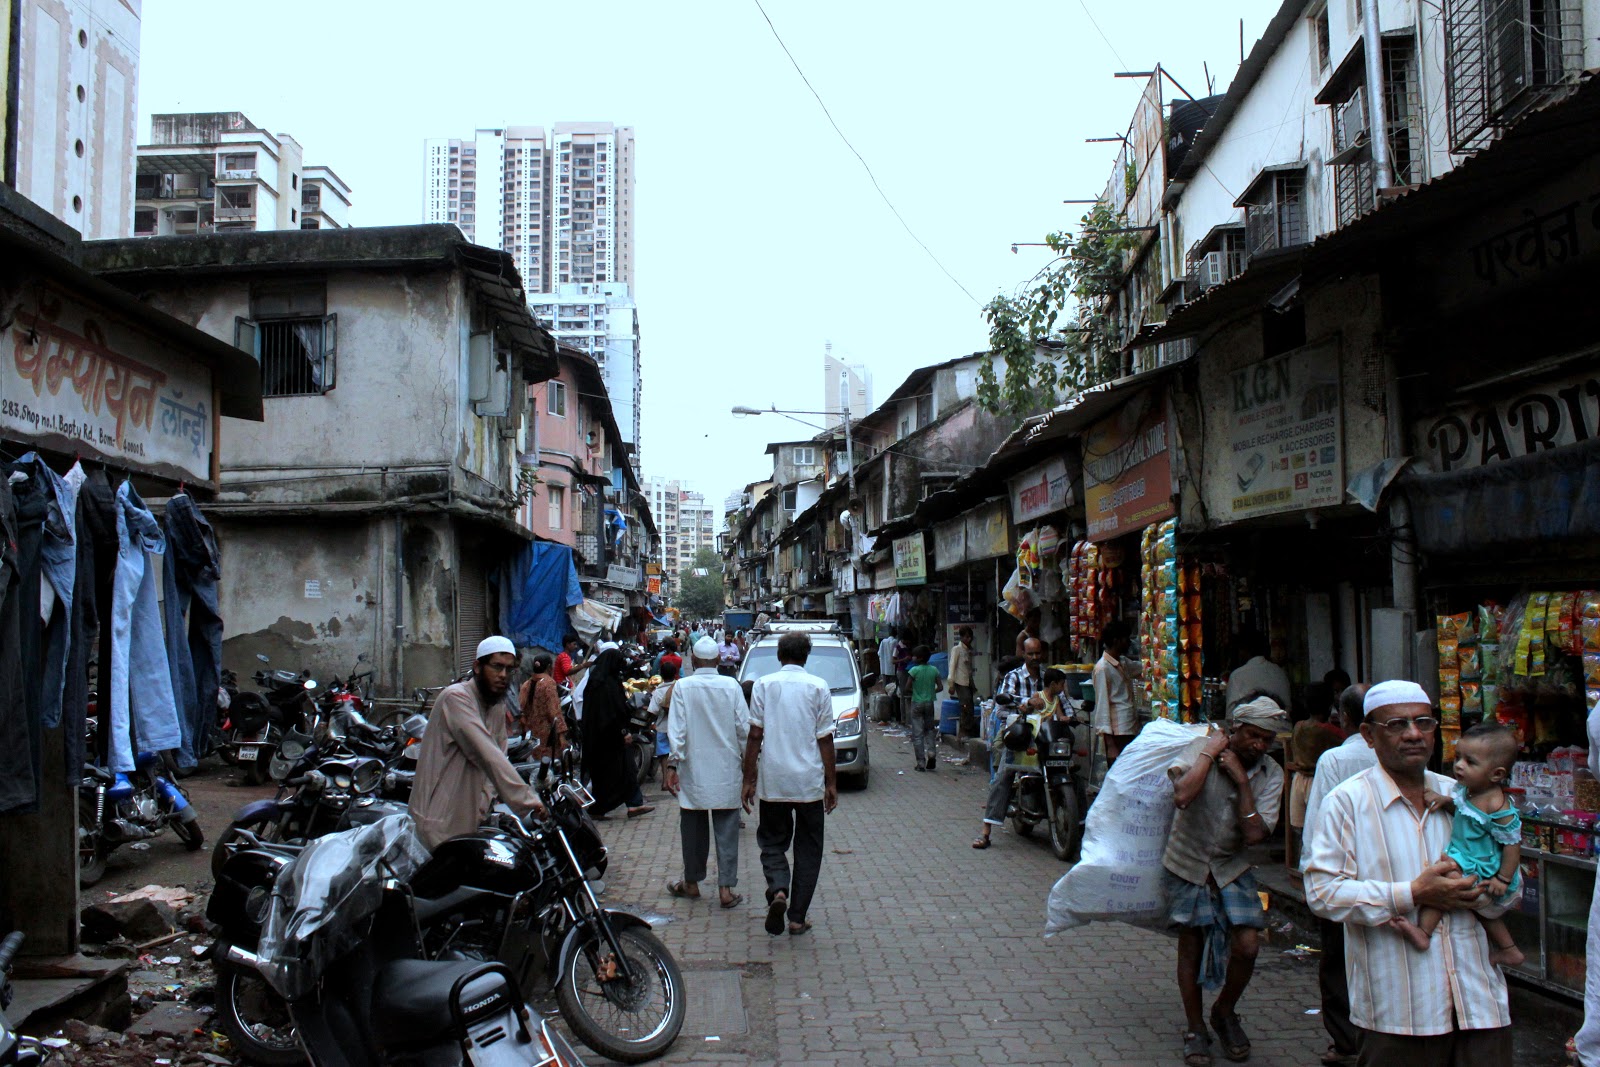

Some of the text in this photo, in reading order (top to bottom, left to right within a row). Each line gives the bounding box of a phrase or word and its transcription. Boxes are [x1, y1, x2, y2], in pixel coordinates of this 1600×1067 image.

[21, 404, 40, 430] Shop
[1233, 437, 1256, 452] MOBILE
[1295, 416, 1336, 436] CHARGERS
[1285, 432, 1336, 452] ACCESSORIES
[1310, 470, 1333, 479] NOKIA
[483, 854, 514, 865] HONDA
[1110, 872, 1142, 884] COUNT
[463, 992, 502, 1015] HONDA
